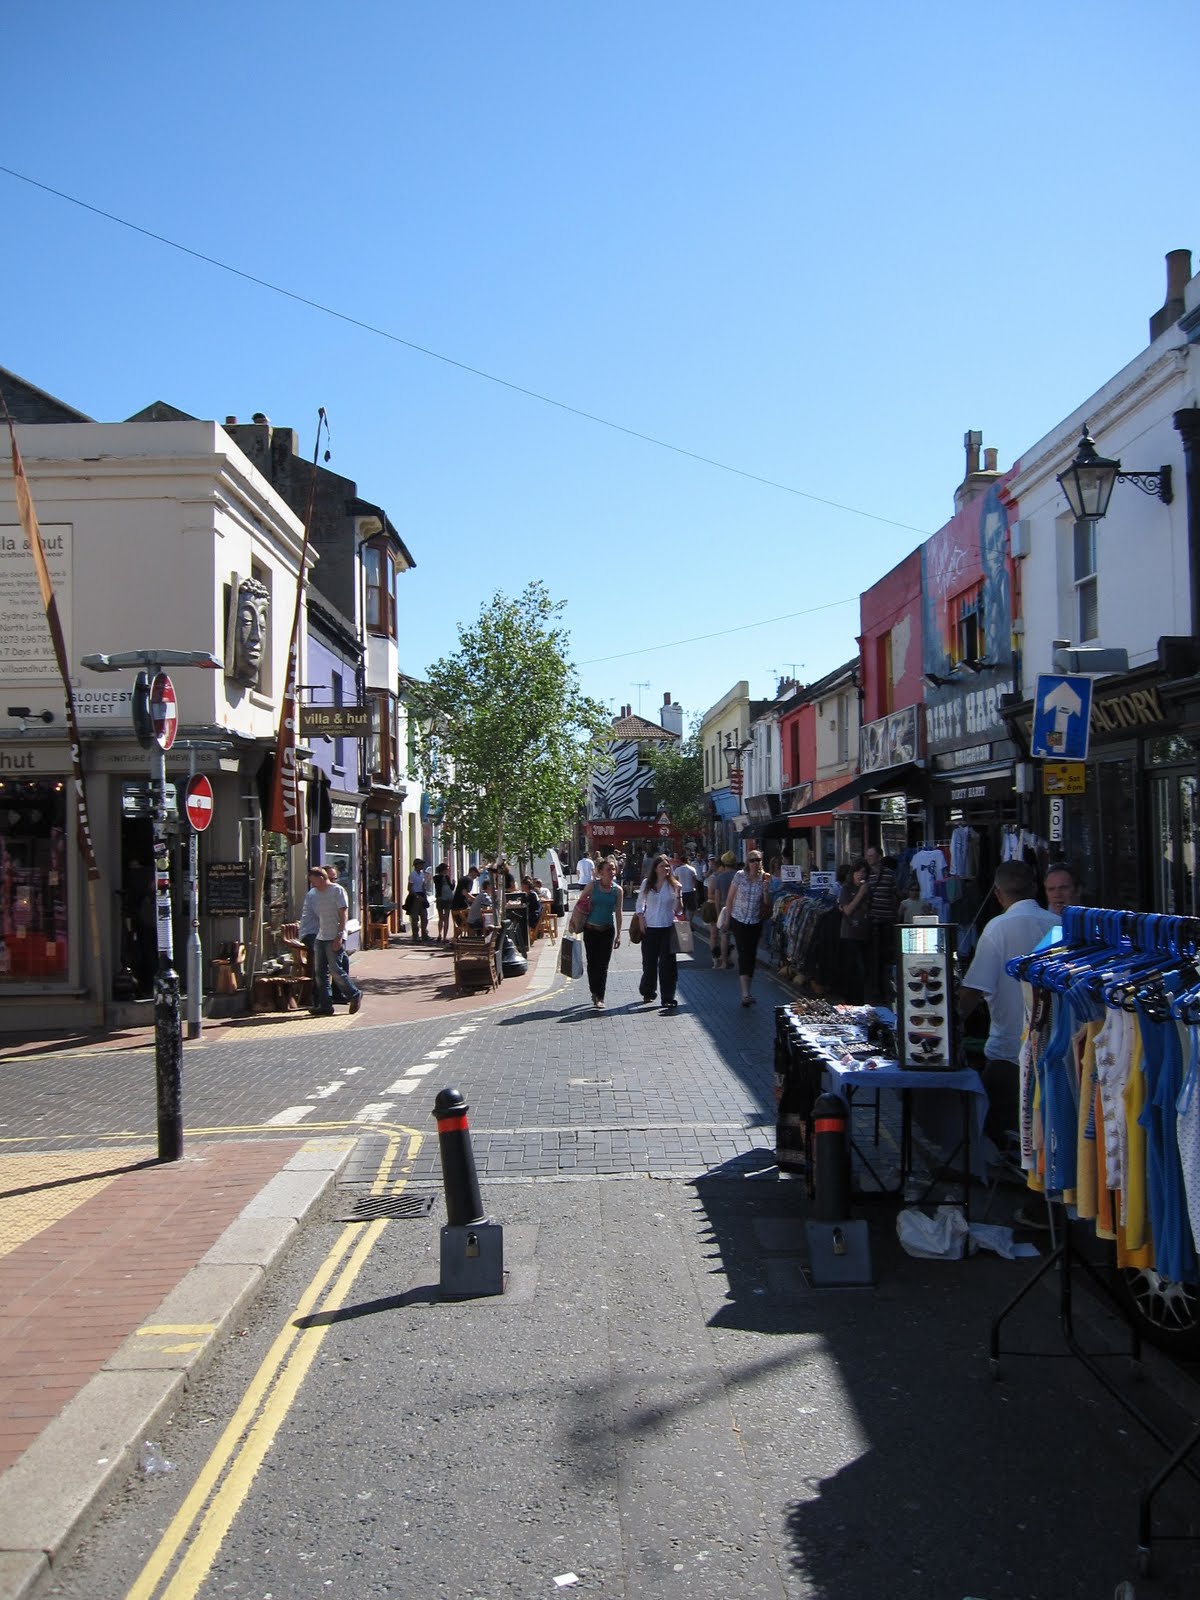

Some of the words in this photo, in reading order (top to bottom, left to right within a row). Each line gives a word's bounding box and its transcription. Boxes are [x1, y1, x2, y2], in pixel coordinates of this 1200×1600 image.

[0, 623, 24, 632] North
[72, 692, 132, 702] GLOUCEST
[1091, 687, 1164, 733] ACTORY
[304, 713, 330, 725] villa
[333, 713, 342, 724] &
[347, 712, 368, 724] hut
[926, 697, 961, 743] DIRTY
[0, 751, 36, 769] hut
